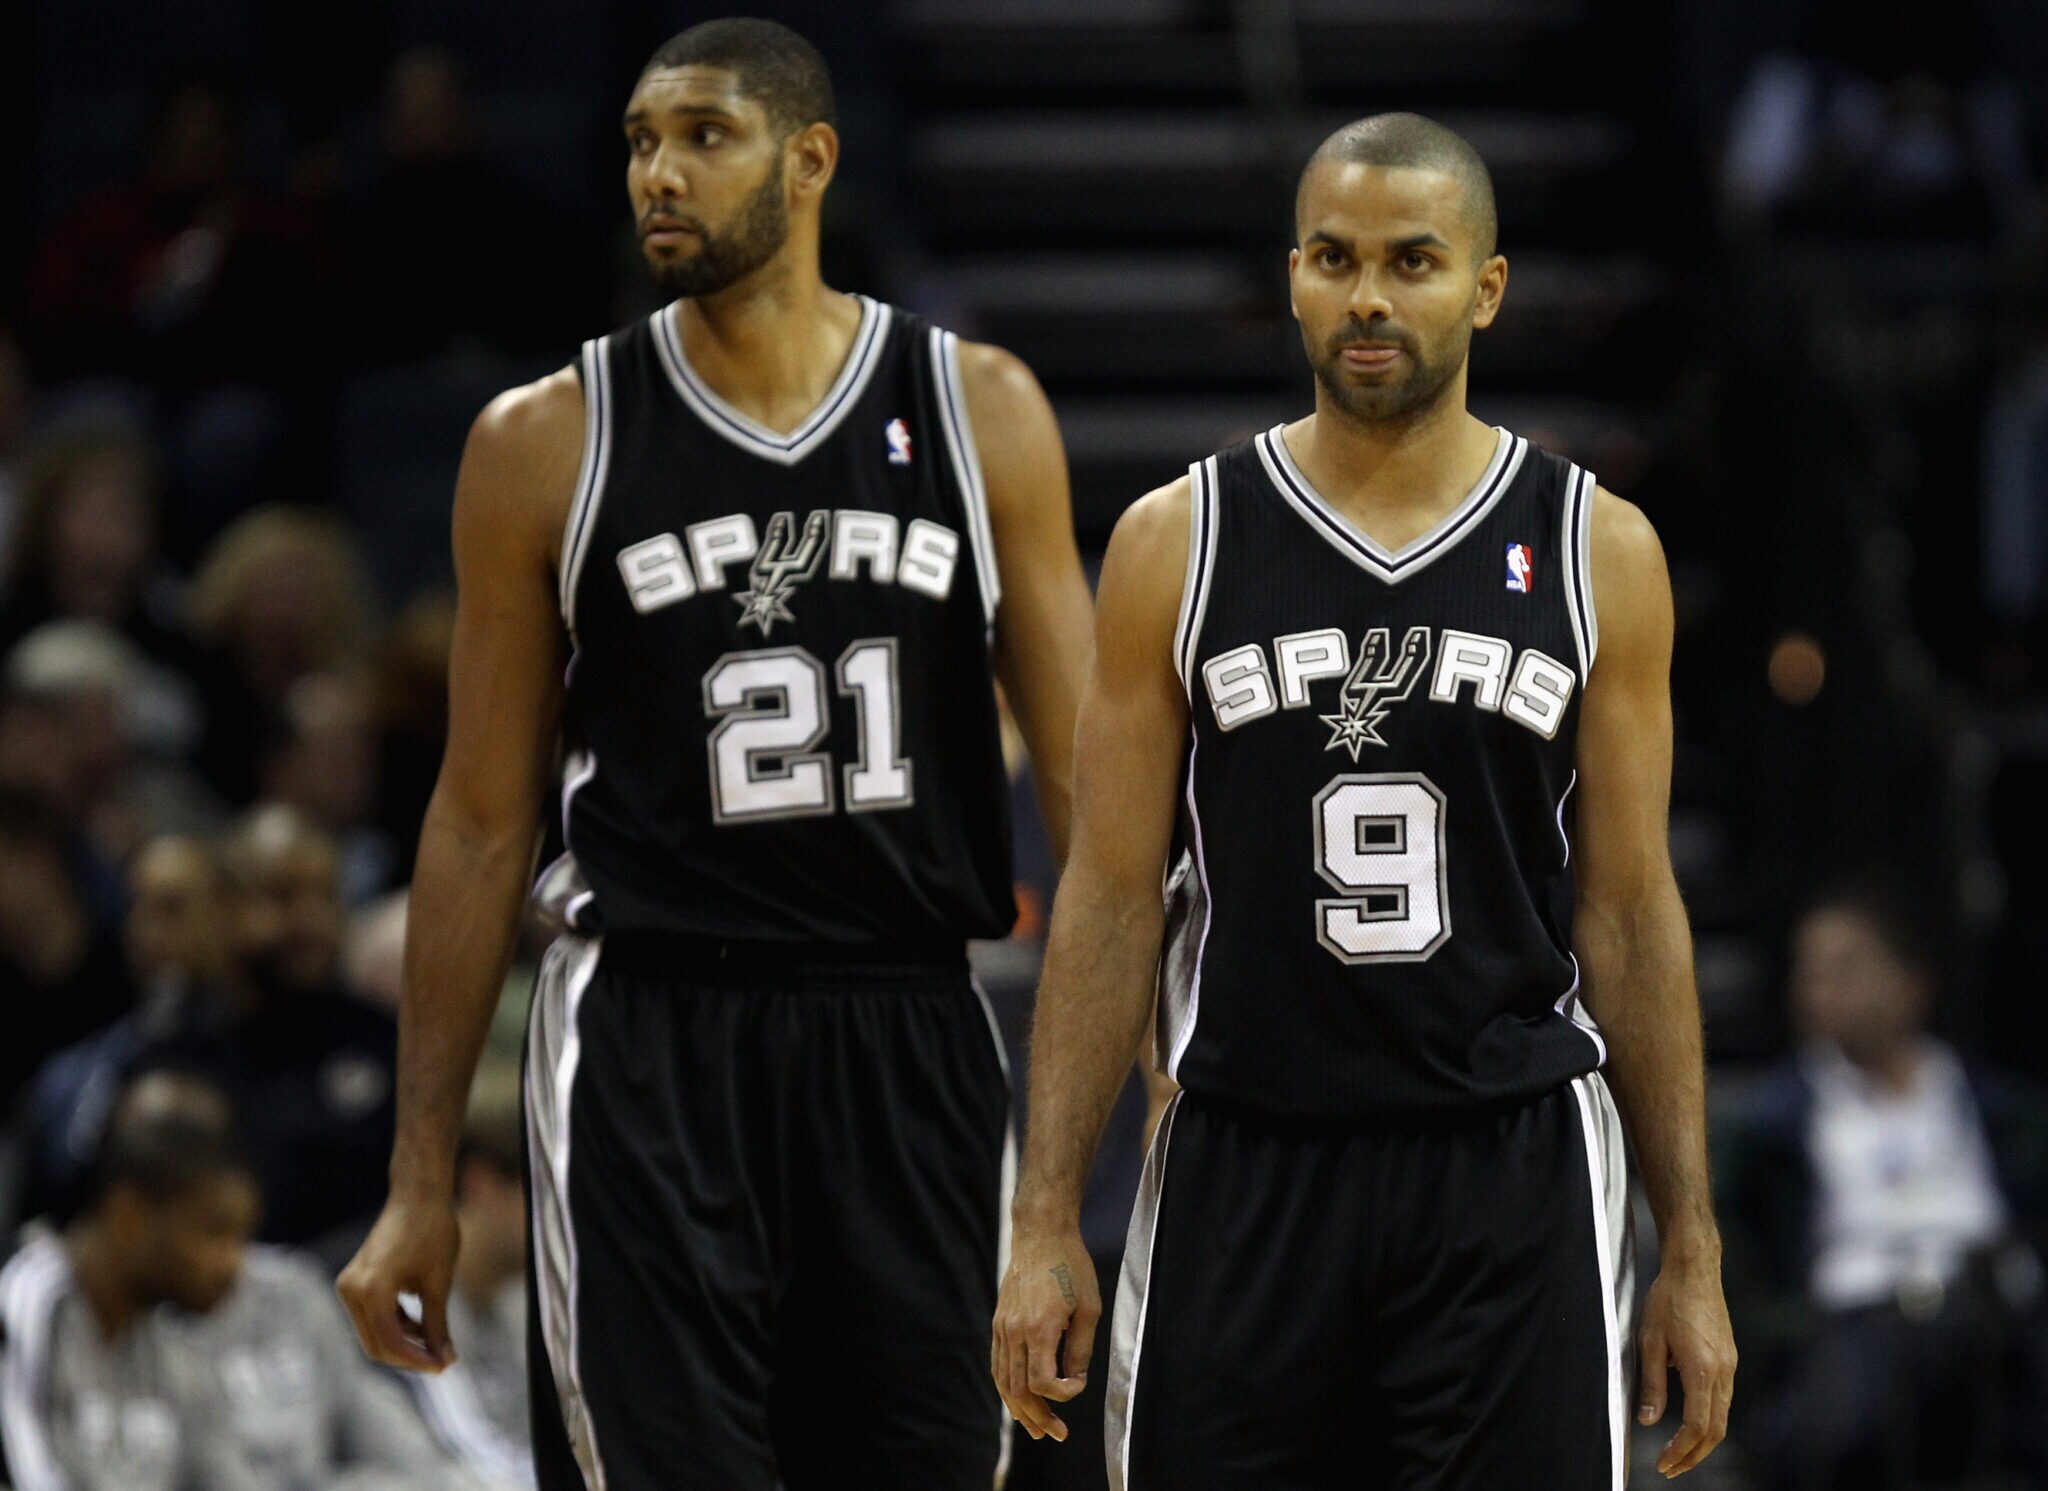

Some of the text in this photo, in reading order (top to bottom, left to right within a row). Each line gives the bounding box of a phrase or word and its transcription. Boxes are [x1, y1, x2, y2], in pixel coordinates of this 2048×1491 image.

[617, 510, 959, 637] SPURS
[702, 637, 913, 826] 21
[1201, 627, 1576, 763] SPURS
[1312, 772, 1452, 965] 9
